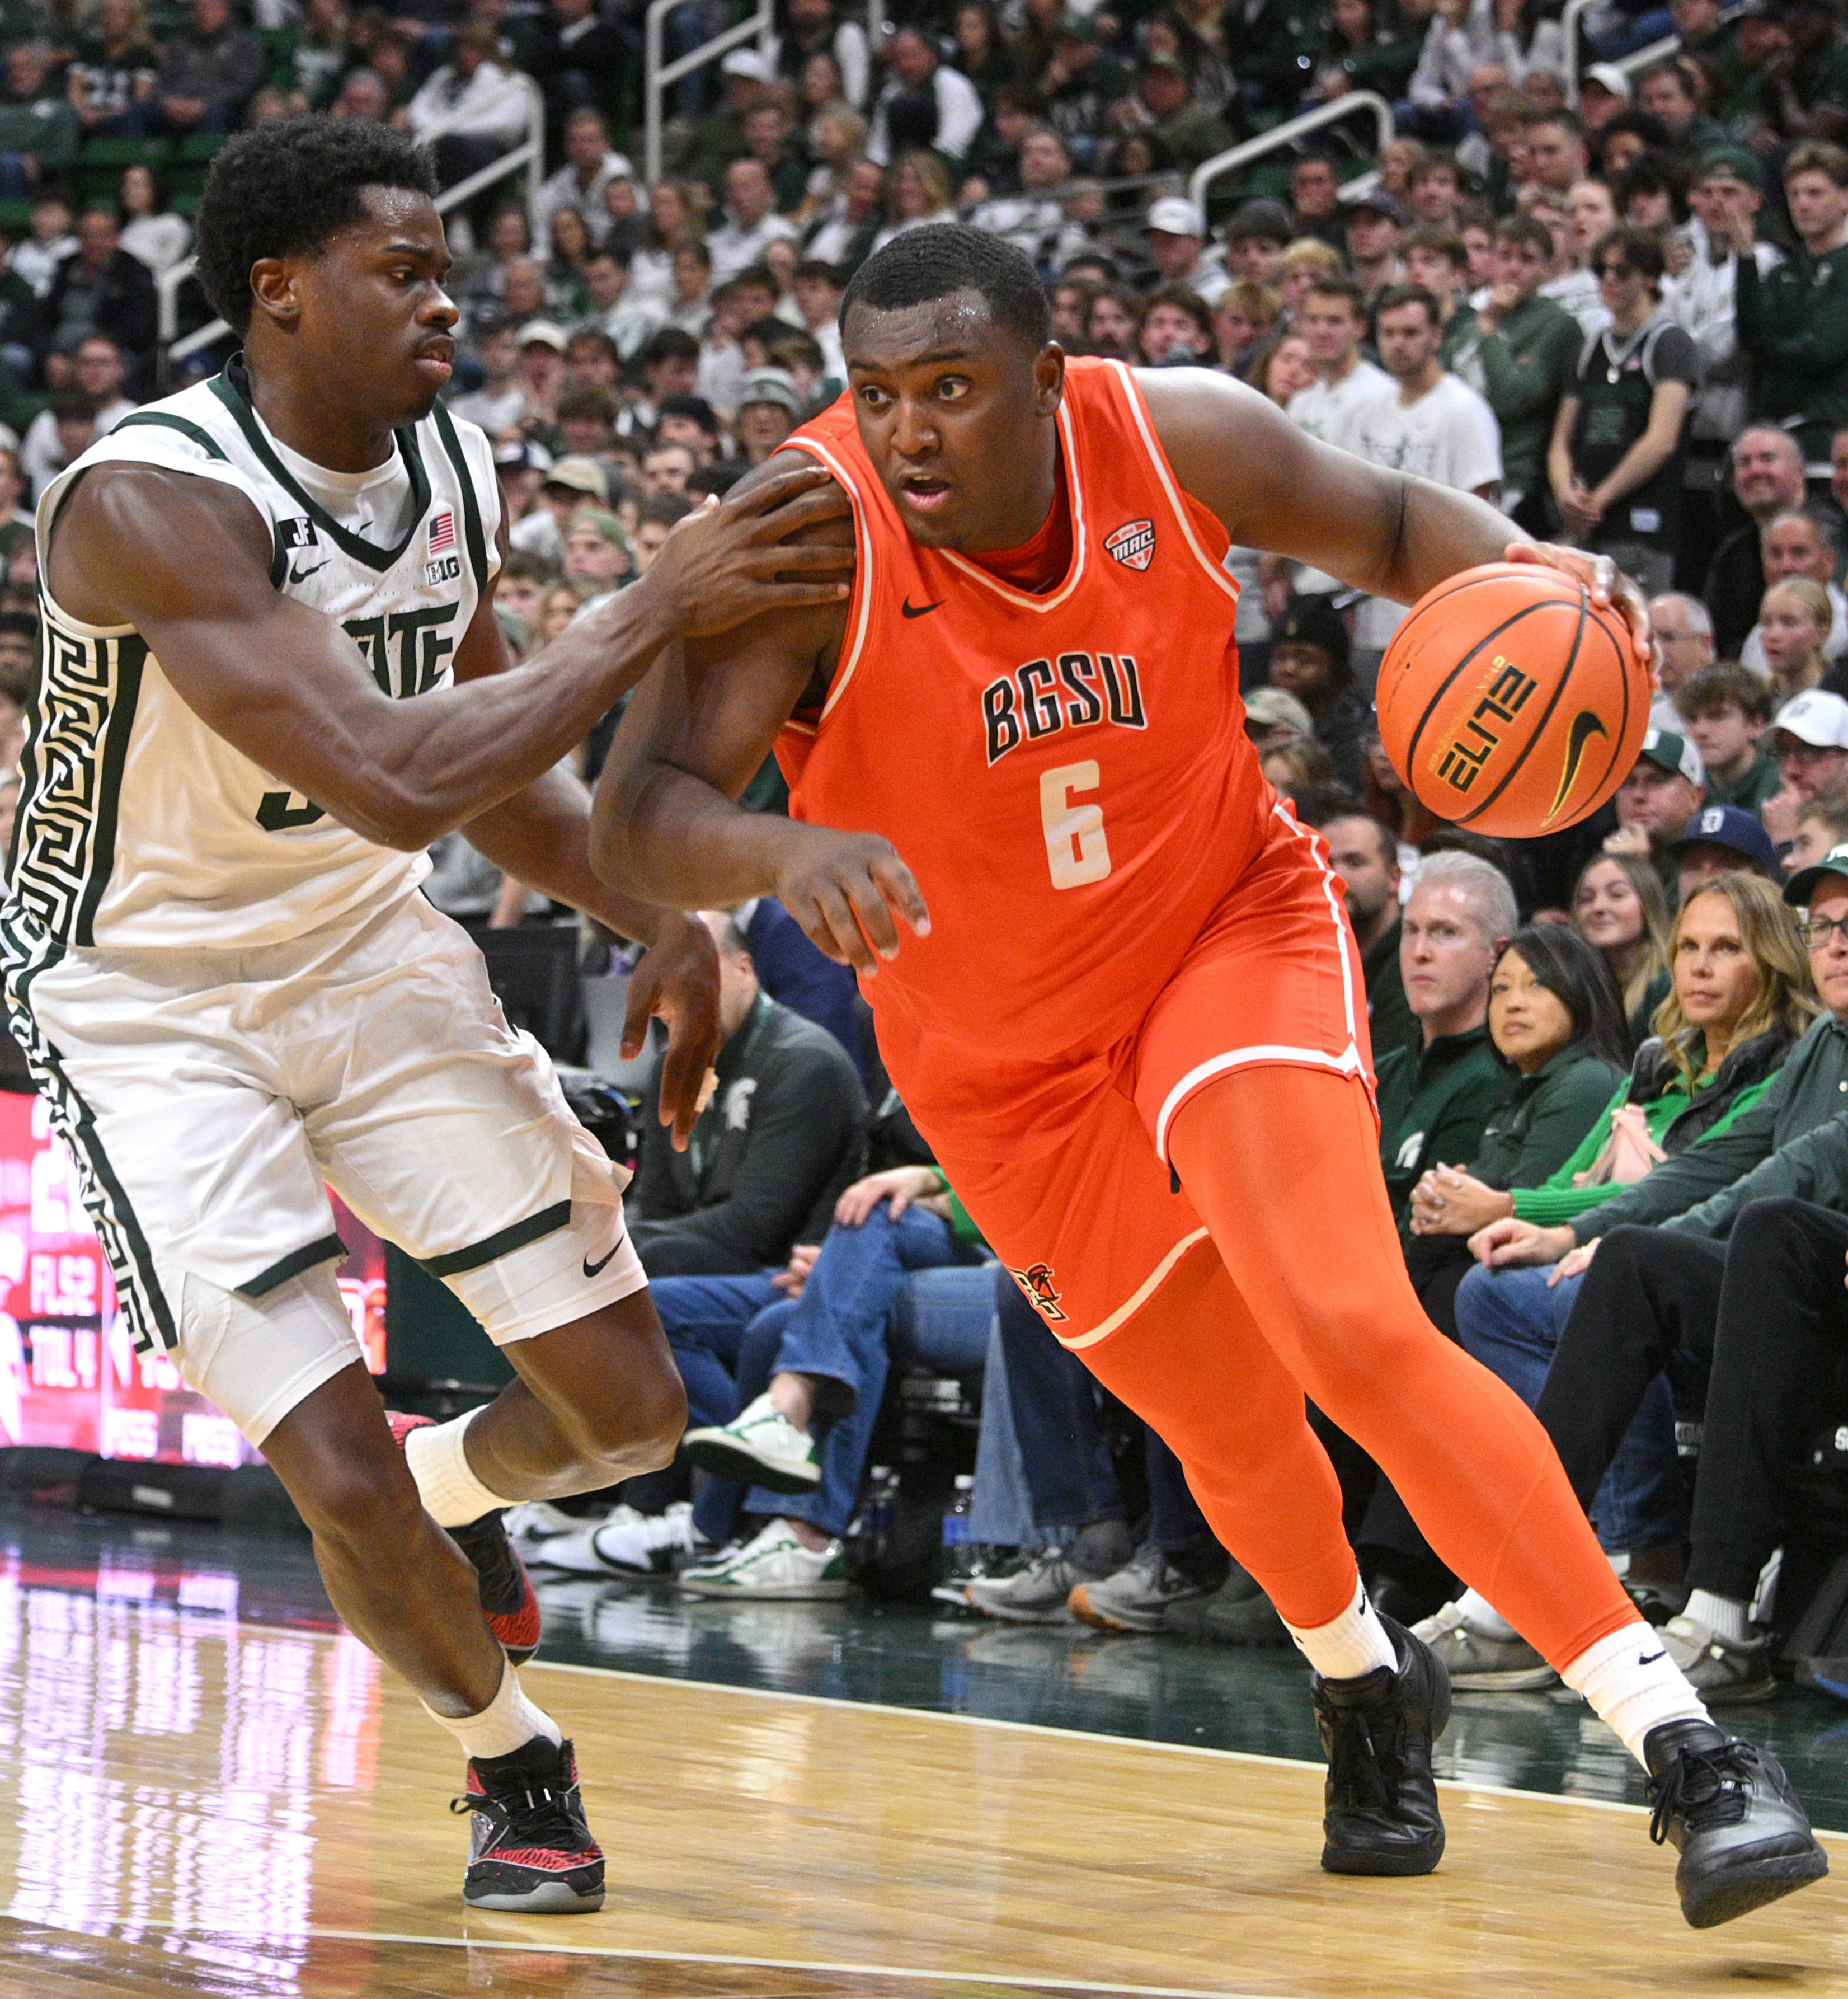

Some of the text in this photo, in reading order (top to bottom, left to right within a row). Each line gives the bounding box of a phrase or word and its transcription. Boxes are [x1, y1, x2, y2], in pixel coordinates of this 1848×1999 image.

[293, 518, 309, 546] JF
[1112, 529, 1155, 561] MAC
[340, 600, 459, 699] ATE
[982, 651, 1148, 768] BGSU
[1436, 663, 1538, 794] ELITE
[1040, 759, 1111, 890] 6
